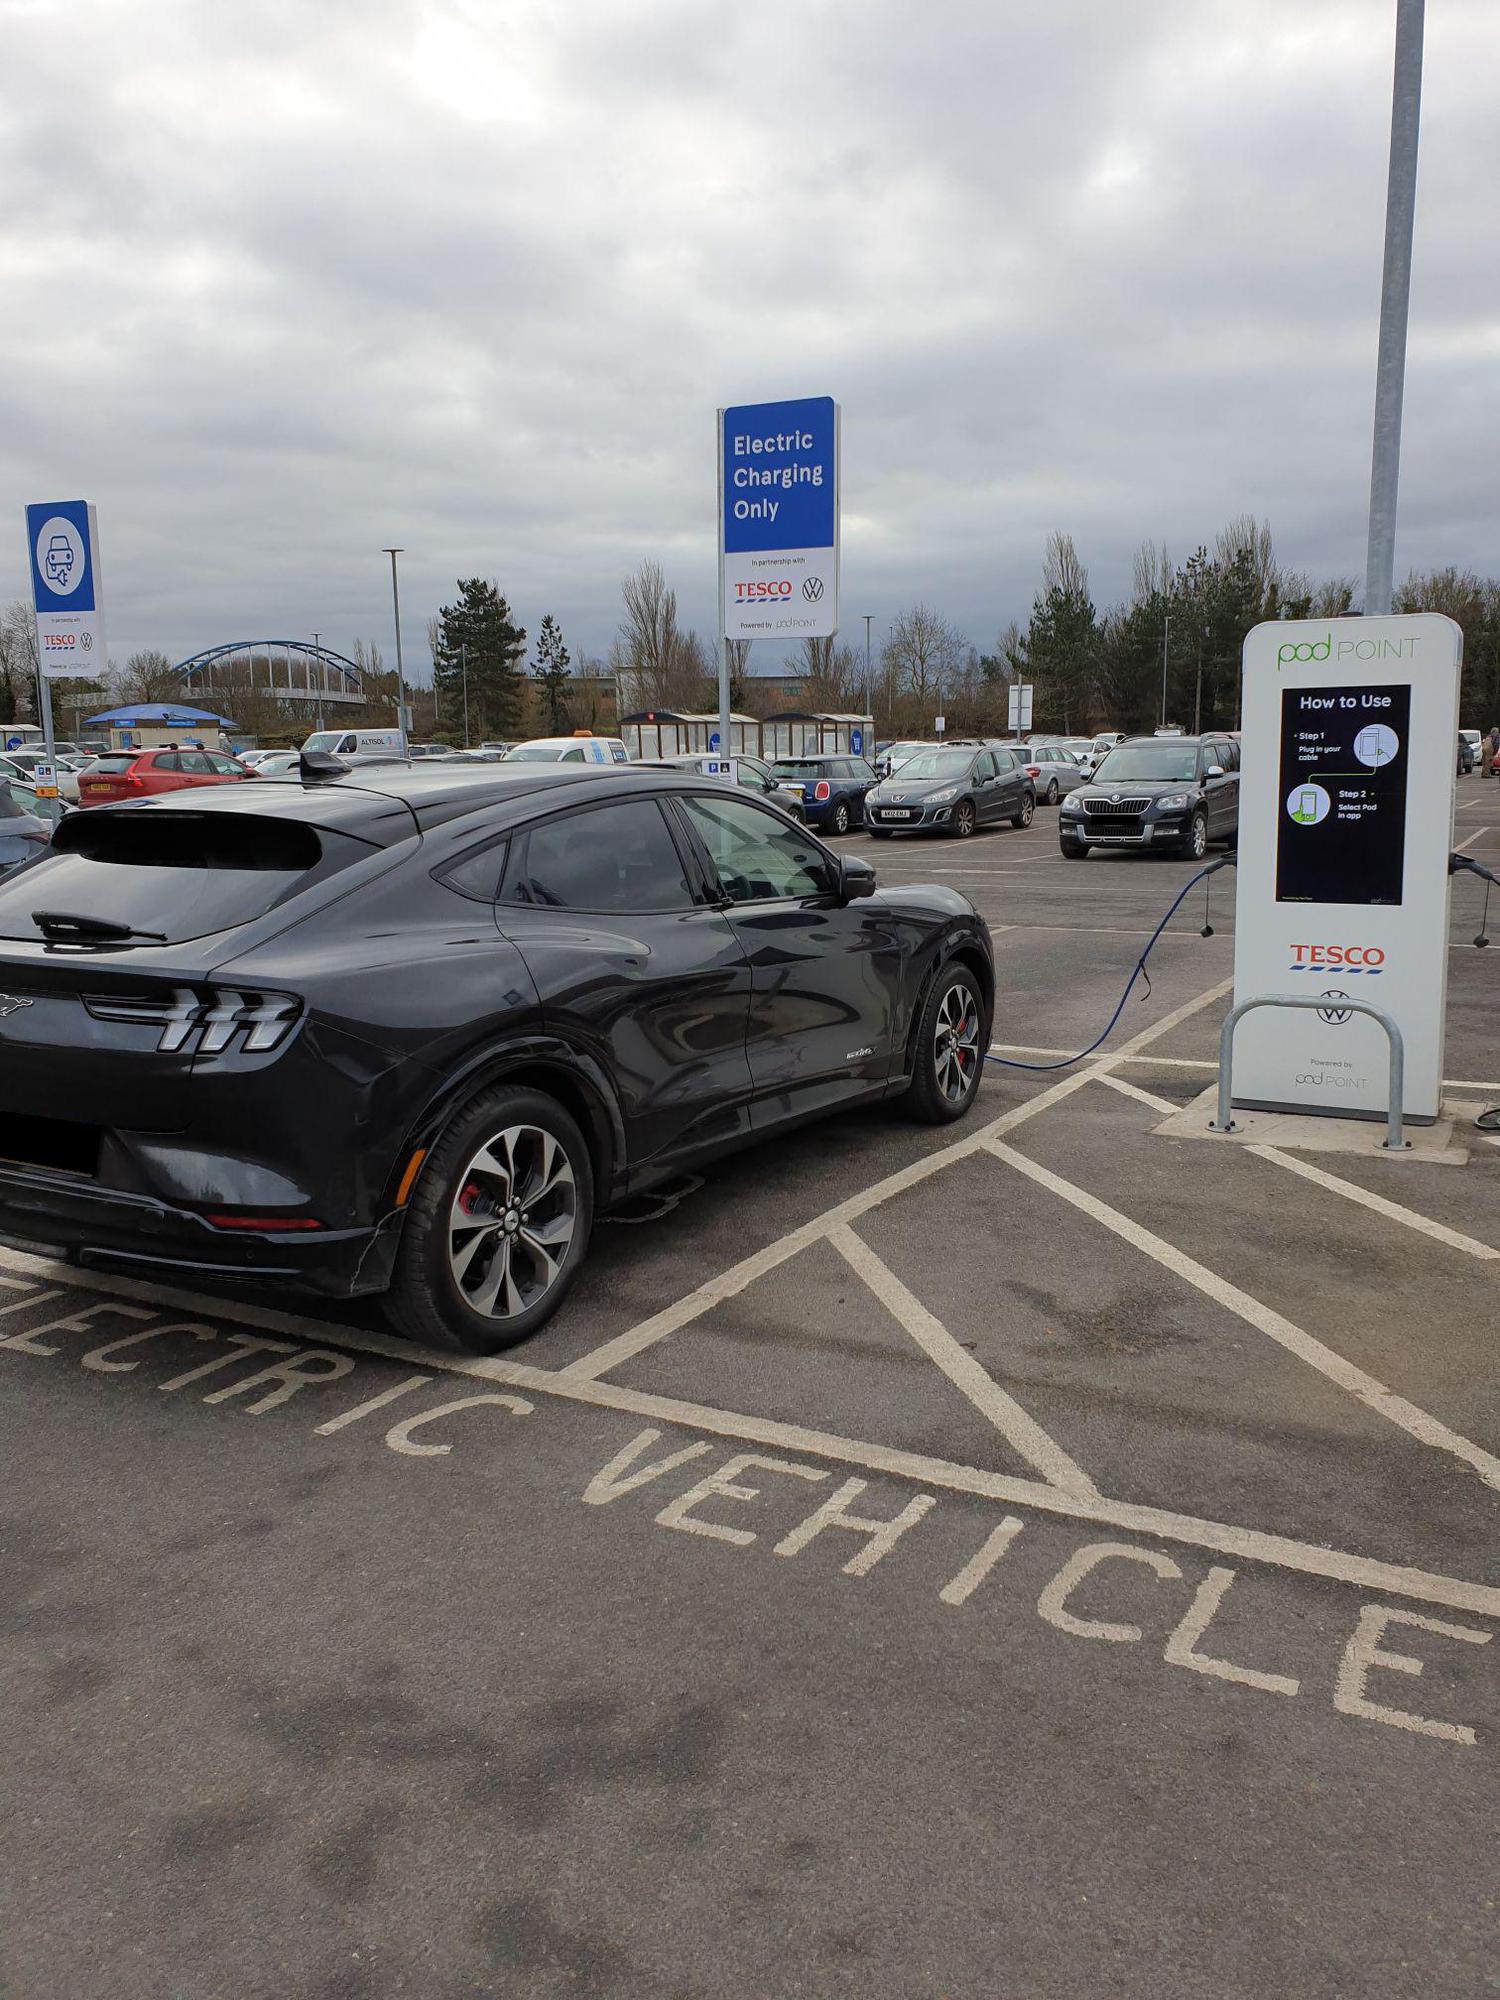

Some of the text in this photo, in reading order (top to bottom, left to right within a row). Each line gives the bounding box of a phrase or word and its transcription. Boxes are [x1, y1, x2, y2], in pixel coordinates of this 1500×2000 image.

[734, 430, 813, 456] Electric
[734, 463, 823, 489] Charging
[734, 498, 779, 522] Only
[758, 558, 791, 567] partnership
[735, 581, 792, 597] TESCO
[765, 621, 772, 629] by
[44, 634, 75, 646] TESCO
[1277, 632, 1421, 672] pod POINT
[1300, 694, 1392, 710] How to Use
[1299, 732, 1325, 741] Step 1
[1298, 746, 1314, 754] Plug
[1339, 790, 1367, 799] Step 2
[1290, 944, 1385, 966] TESCO
[1326, 1076, 1368, 1089] POINT
[582, 1428, 1495, 1744] VEHICLE
